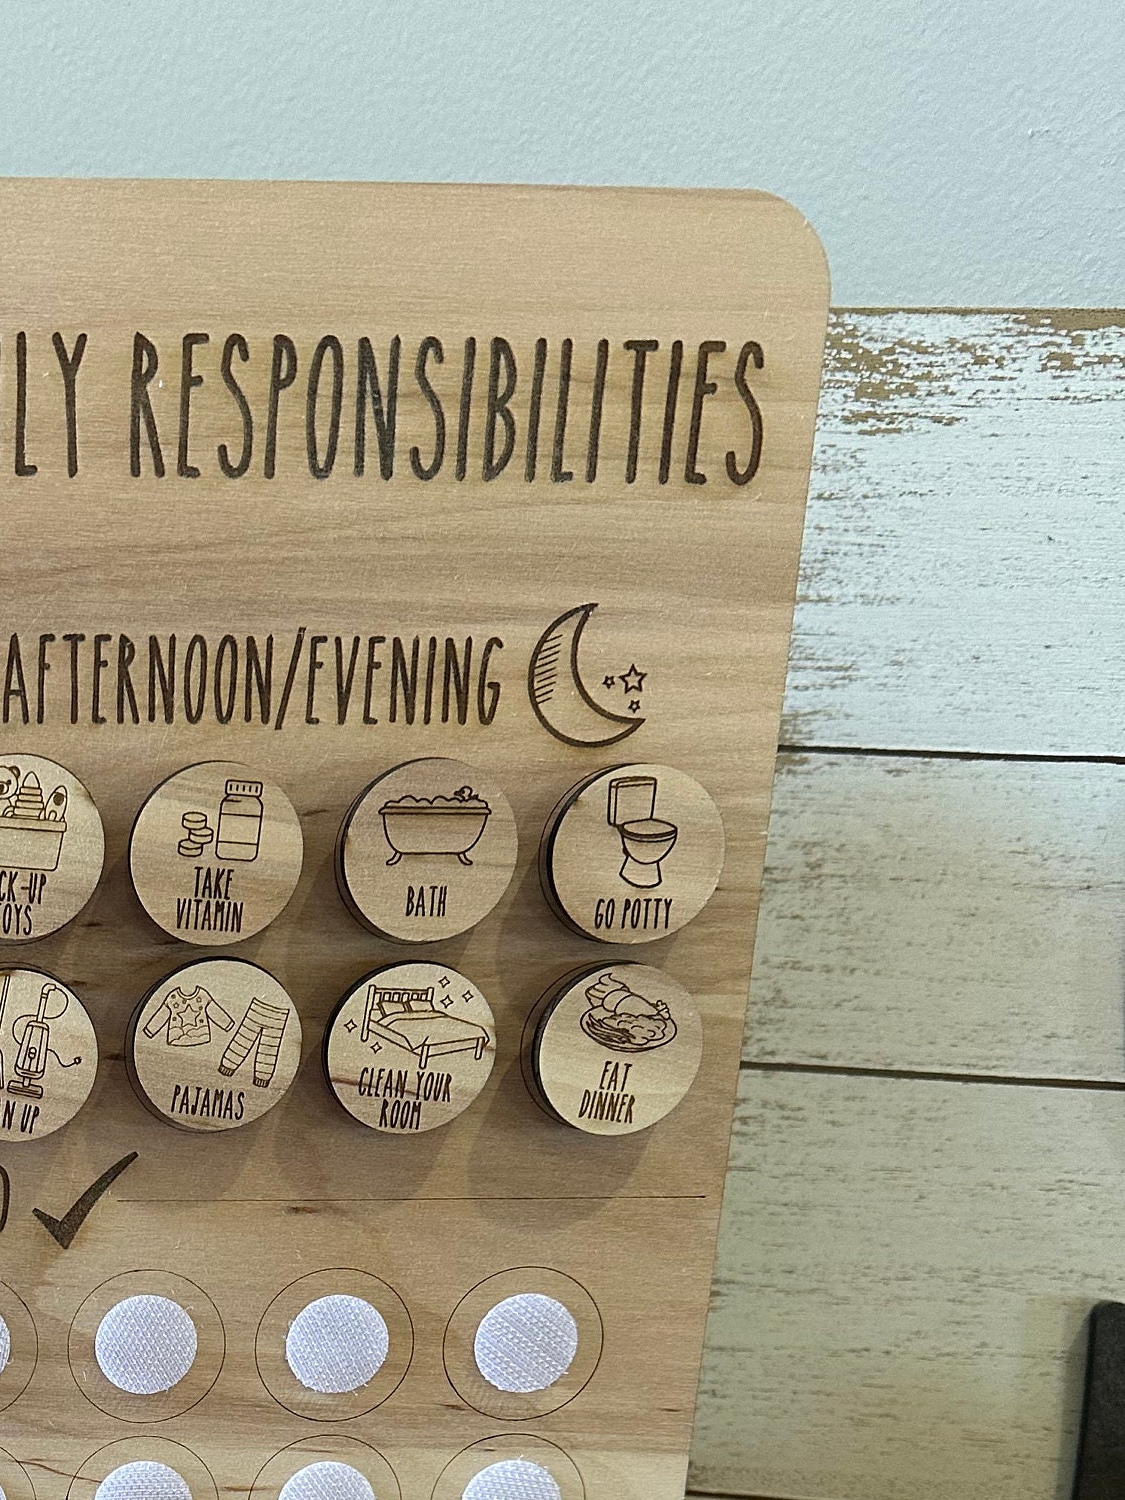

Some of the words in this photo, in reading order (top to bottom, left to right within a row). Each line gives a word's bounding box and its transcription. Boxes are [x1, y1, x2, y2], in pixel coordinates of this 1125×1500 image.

[128, 332, 764, 486] RESPONSIBILITIES
[1, 627, 504, 730] AFTERNOON/EVENING
[193, 866, 235, 901] TAKE
[176, 899, 244, 933] VITAMIN
[405, 886, 447, 917] BATH
[594, 898, 615, 929] GO
[621, 898, 672, 930] POTTY
[358, 1067, 409, 1099] CLEAN
[414, 1071, 452, 1103] YOUR
[599, 1060, 633, 1092] EAT
[20, 1104, 40, 1135] UP
[171, 1085, 245, 1121] PAJAMAS
[379, 1100, 422, 1130] ROOM
[578, 1090, 635, 1124] DINNER
